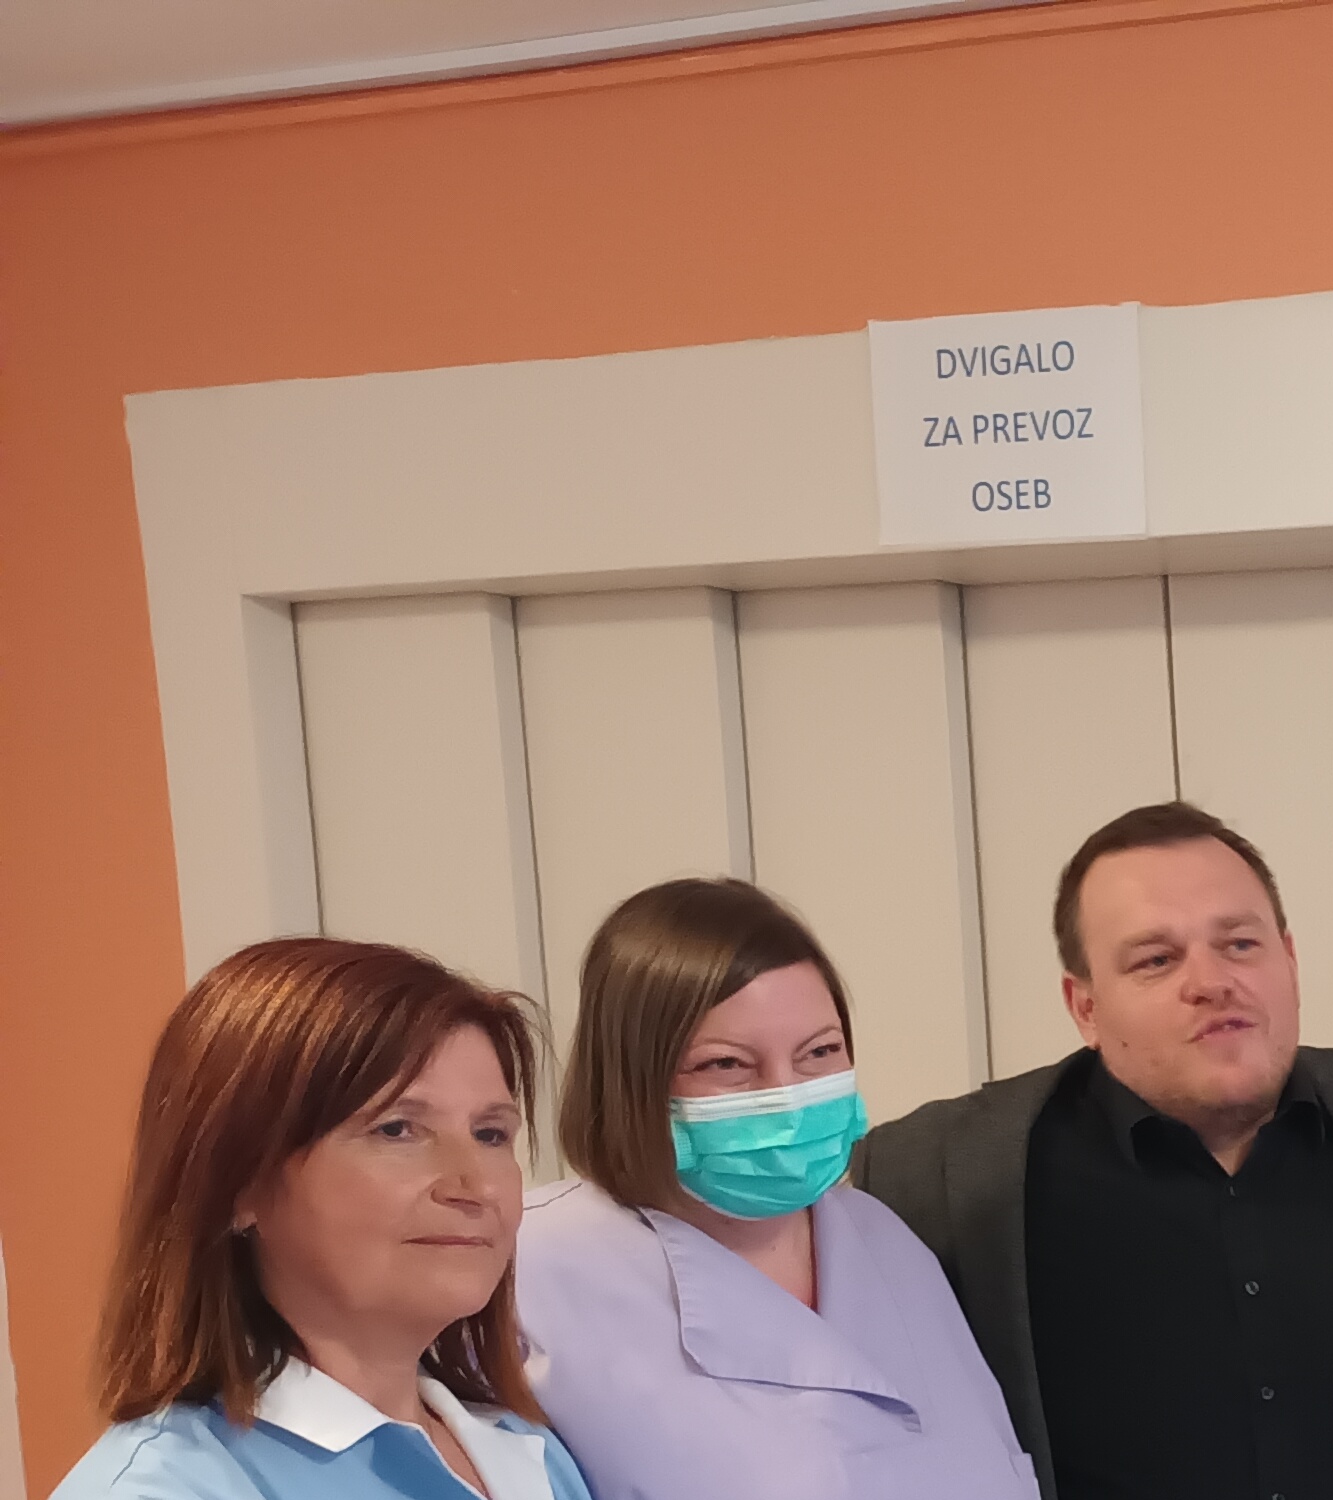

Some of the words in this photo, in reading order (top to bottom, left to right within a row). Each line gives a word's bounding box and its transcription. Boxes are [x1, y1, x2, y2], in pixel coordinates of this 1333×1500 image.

[936, 340, 1075, 379] DVIGALO
[923, 415, 963, 448] ZA
[972, 407, 1094, 446] PREVOZ
[972, 478, 1052, 512] OSEB
